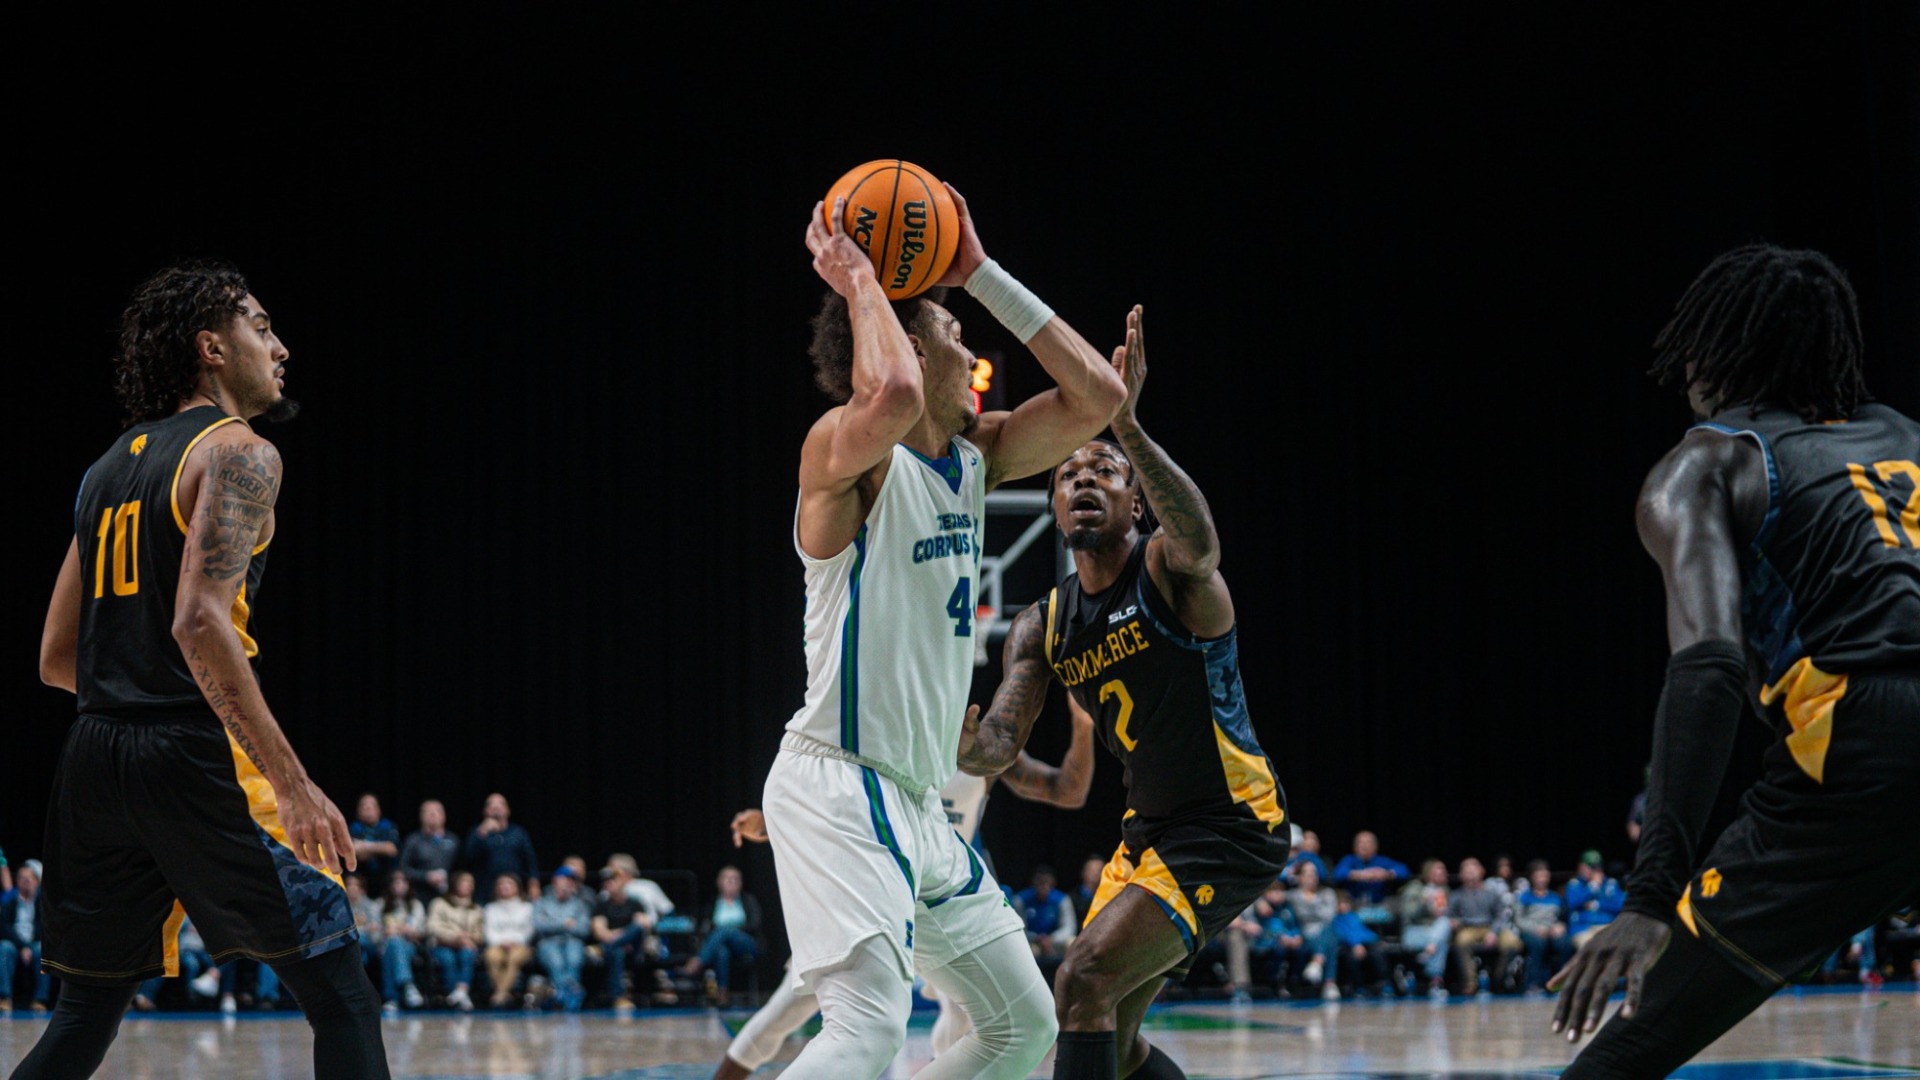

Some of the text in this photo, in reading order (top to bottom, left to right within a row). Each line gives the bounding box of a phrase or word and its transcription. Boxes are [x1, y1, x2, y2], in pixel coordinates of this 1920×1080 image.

[889, 200, 927, 290] Wilson
[94, 500, 141, 599] 10
[912, 532, 971, 564] CORPUS
[946, 576, 972, 638] 4
[1099, 678, 1139, 753] 2
